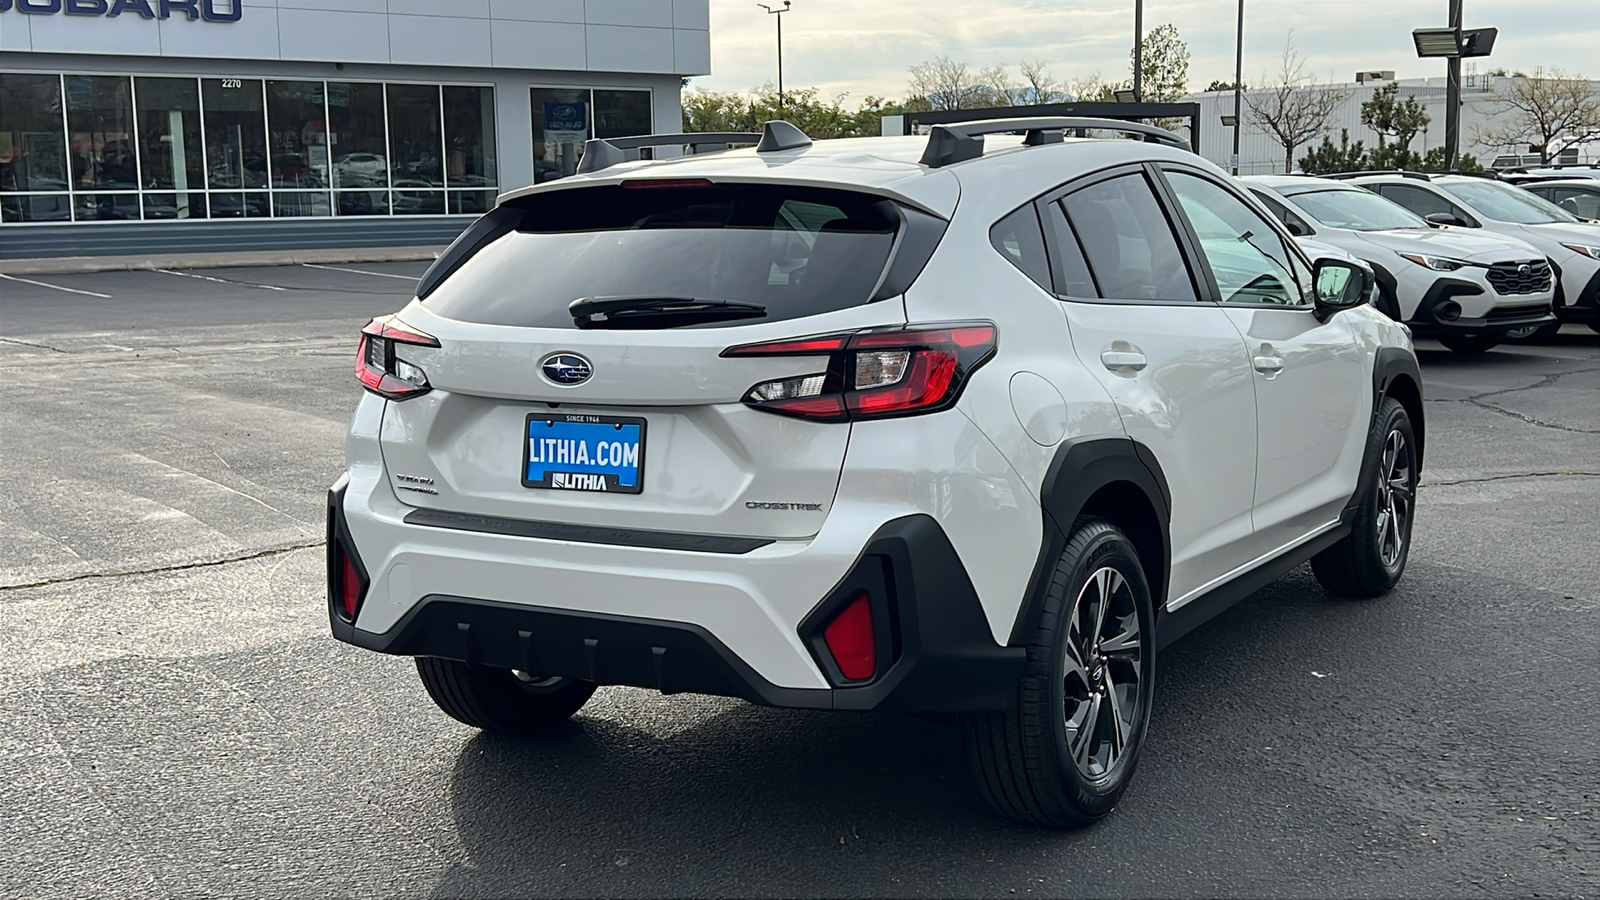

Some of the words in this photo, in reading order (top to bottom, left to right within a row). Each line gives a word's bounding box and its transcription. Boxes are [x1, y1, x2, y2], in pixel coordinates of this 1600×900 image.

[0, 0, 242, 23] BARU
[221, 78, 242, 89] 2270
[566, 415, 585, 423] SINCE
[529, 437, 640, 468] LITHIA.COM
[564, 473, 607, 491] LITHIA
[745, 500, 823, 511] CROSSTREK
